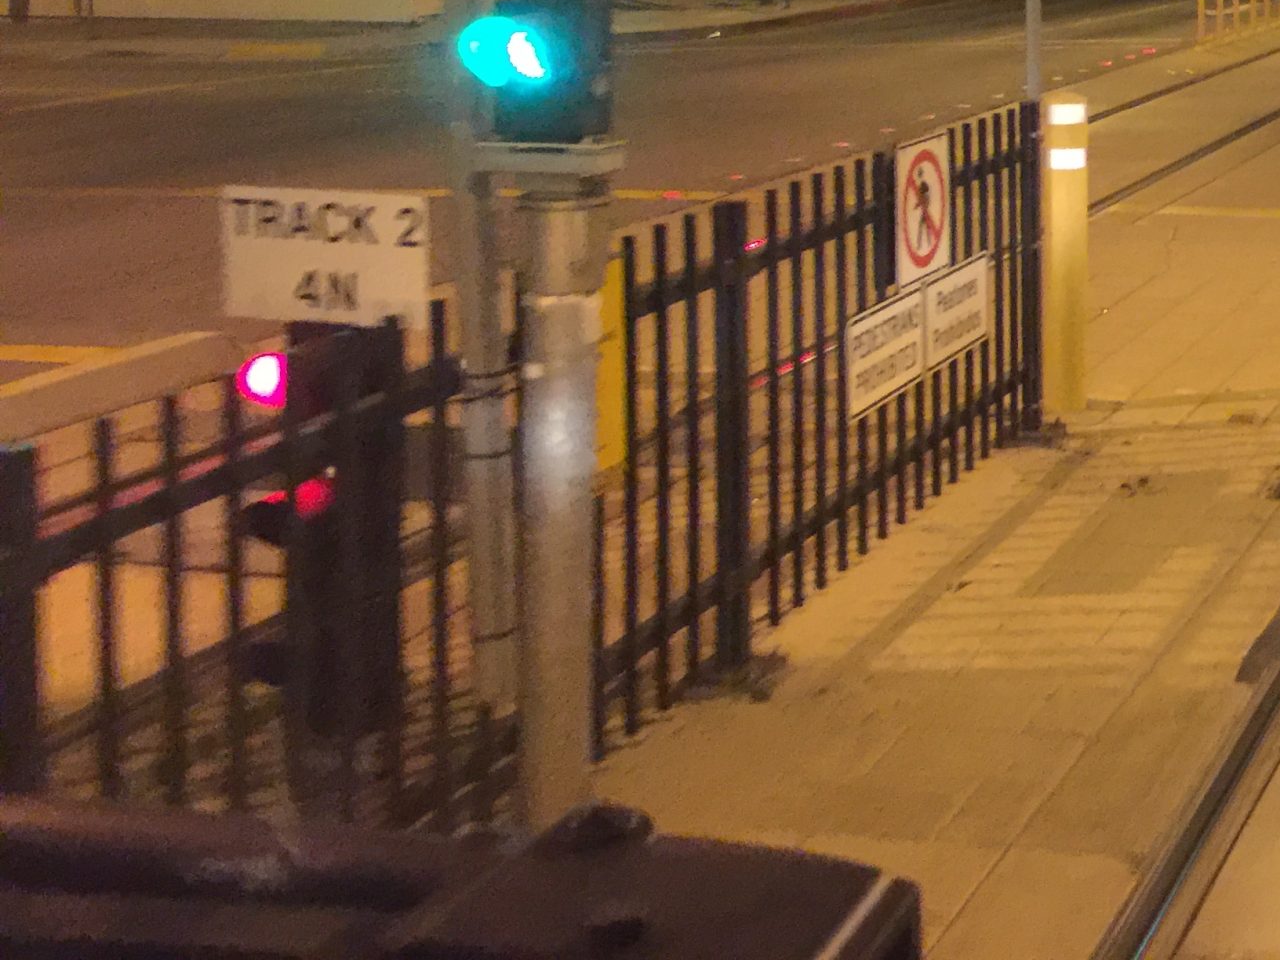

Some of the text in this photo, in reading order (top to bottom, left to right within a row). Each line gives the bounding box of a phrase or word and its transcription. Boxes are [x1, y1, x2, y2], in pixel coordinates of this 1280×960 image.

[231, 197, 423, 248] TRACK 2
[295, 269, 359, 312] 4N
